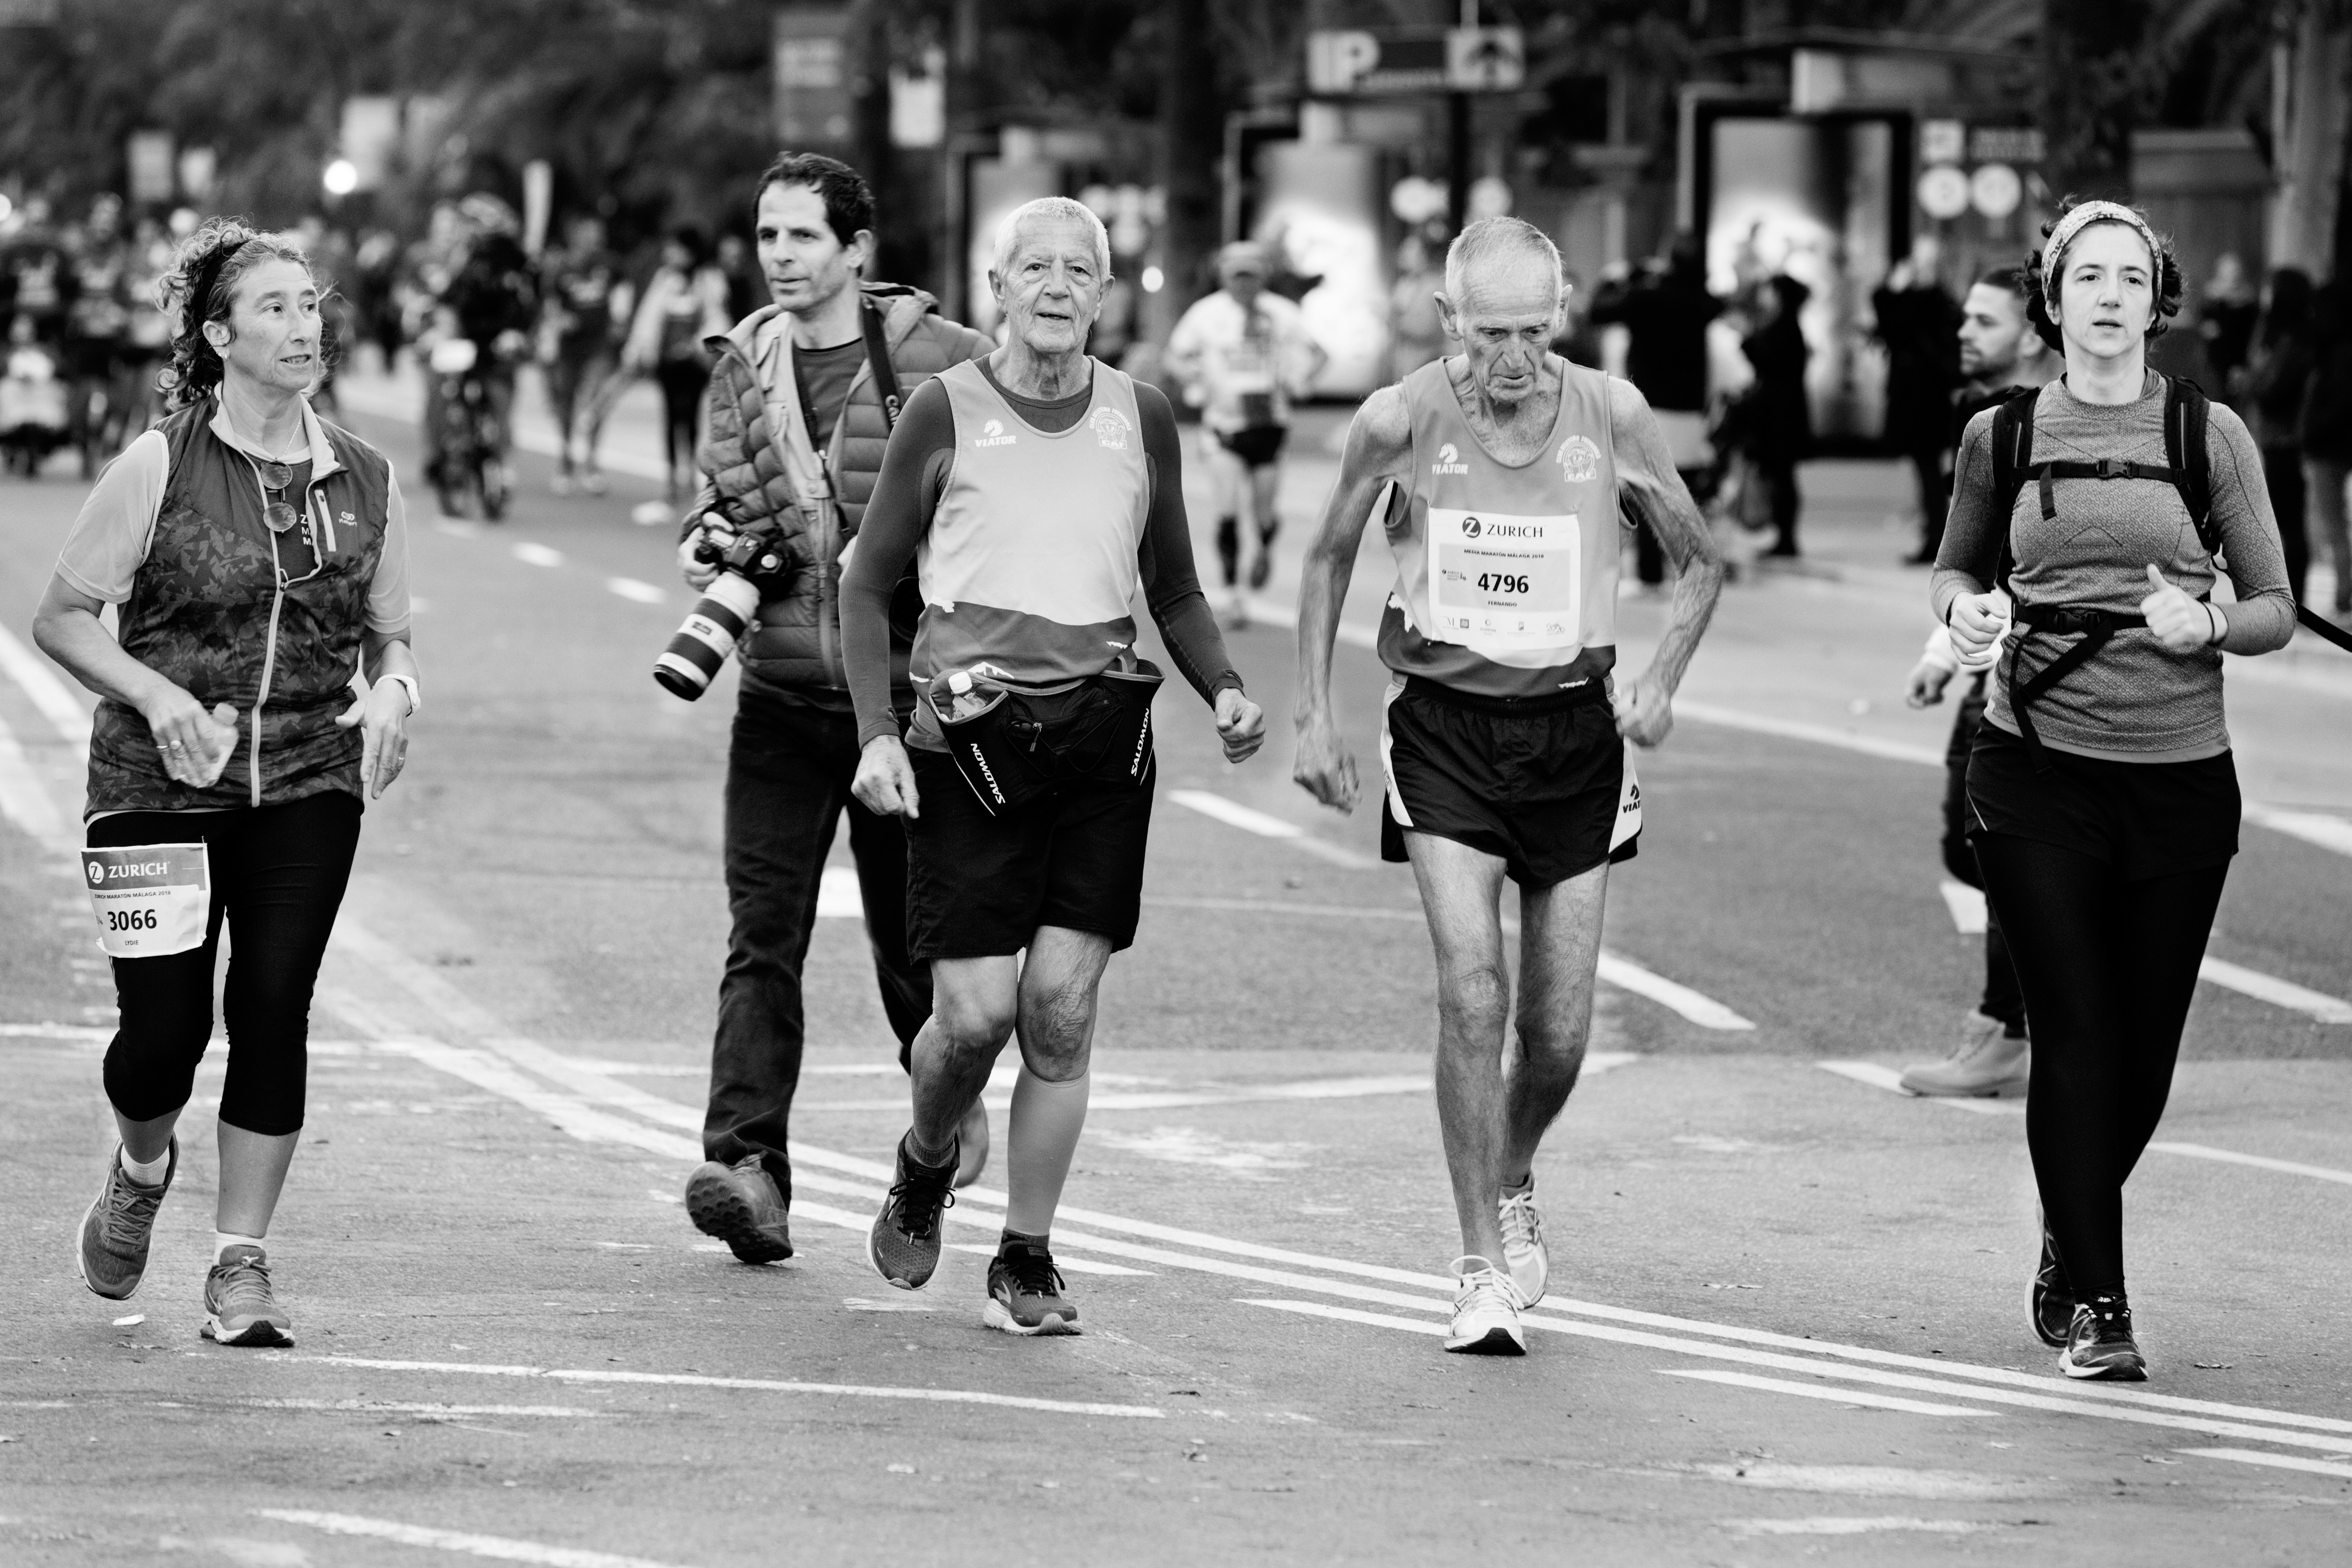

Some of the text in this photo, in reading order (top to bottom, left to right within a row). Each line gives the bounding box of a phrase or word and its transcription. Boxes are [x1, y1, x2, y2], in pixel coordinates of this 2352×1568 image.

[975, 435, 1016, 447] VIATOR
[1432, 463, 1468, 474] VIATOR
[1487, 523, 1543, 538] ZURICH
[1478, 572, 1529, 593] 4796
[1131, 708, 1149, 776] SALOMON
[971, 743, 1005, 804] SALOMON
[108, 862, 167, 878] ZURICH
[107, 909, 157, 931] 3066
